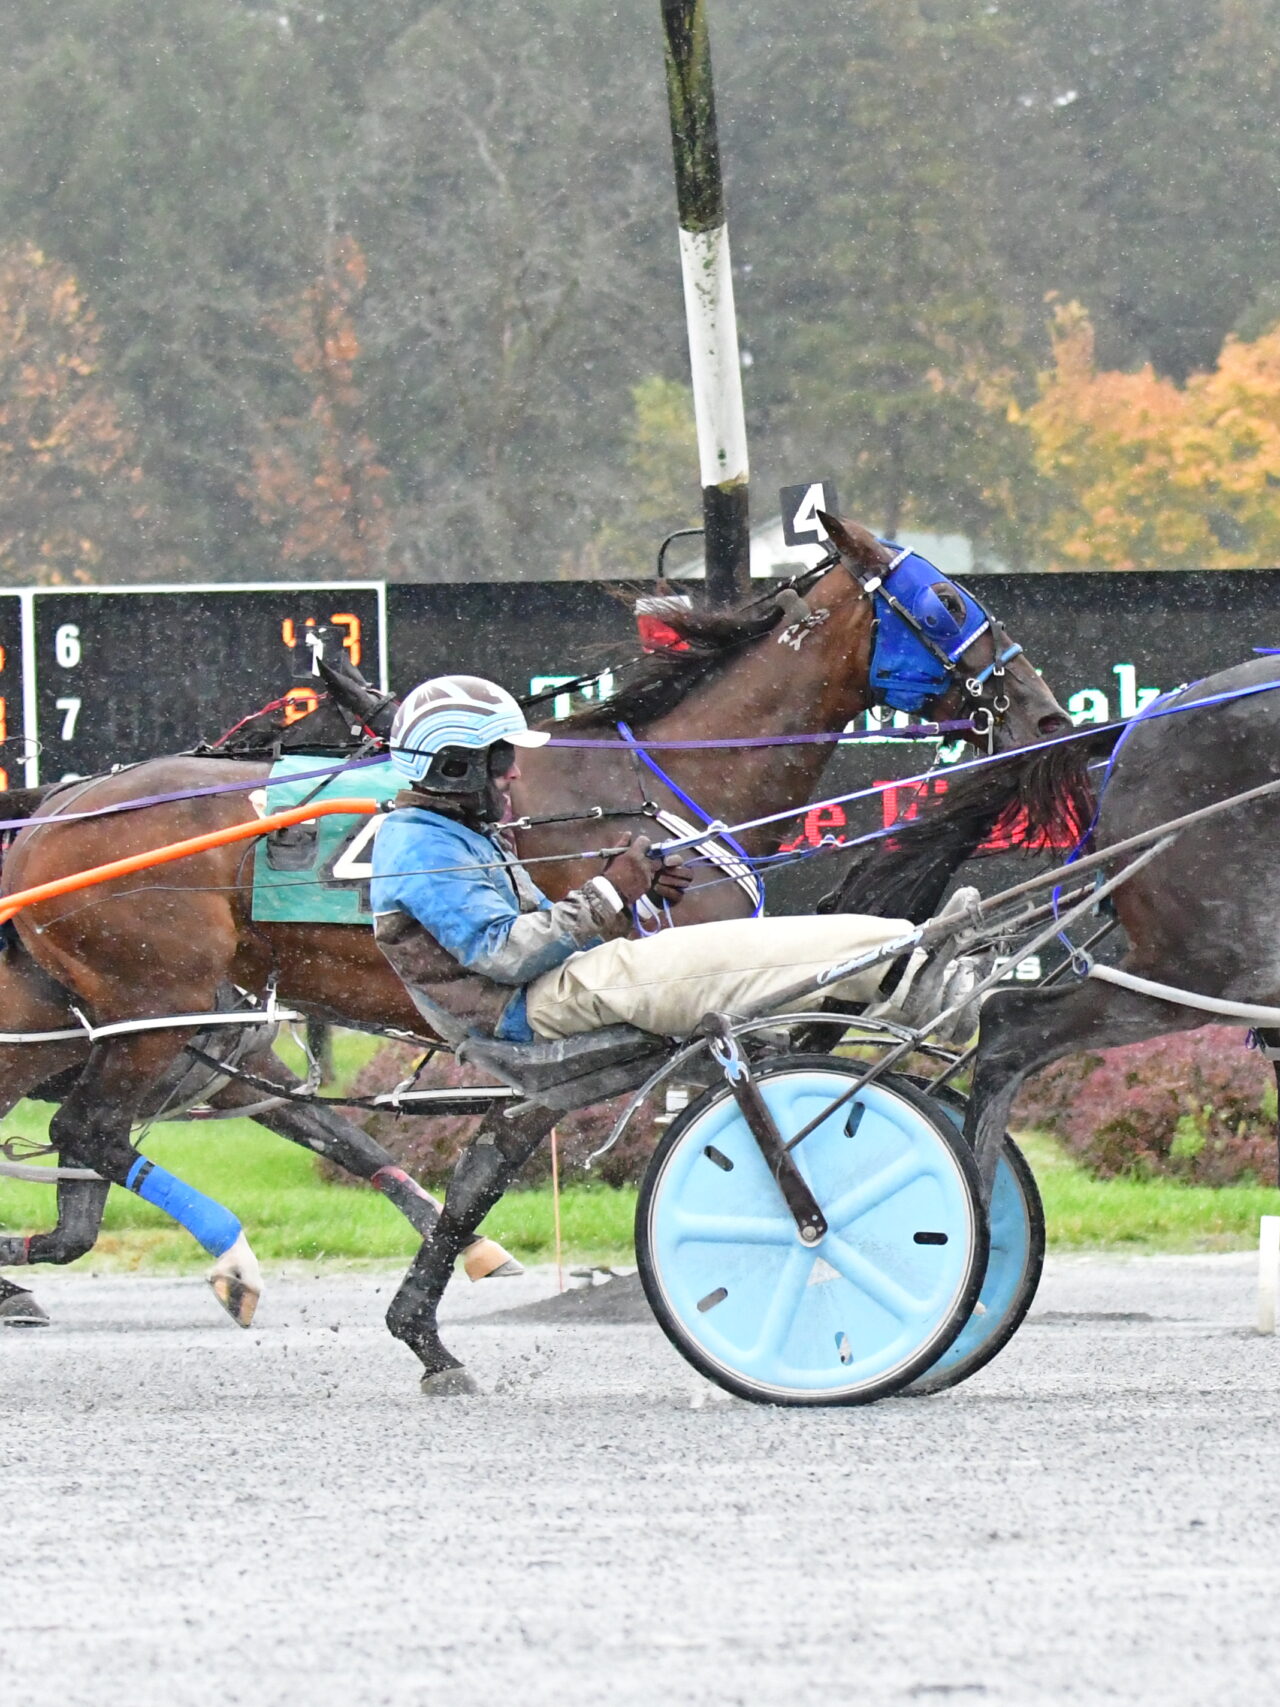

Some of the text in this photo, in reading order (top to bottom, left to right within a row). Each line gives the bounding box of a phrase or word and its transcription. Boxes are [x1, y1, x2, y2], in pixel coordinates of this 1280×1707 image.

[792, 483, 829, 542] 4
[55, 623, 81, 669] 6
[55, 697, 82, 741] 7
